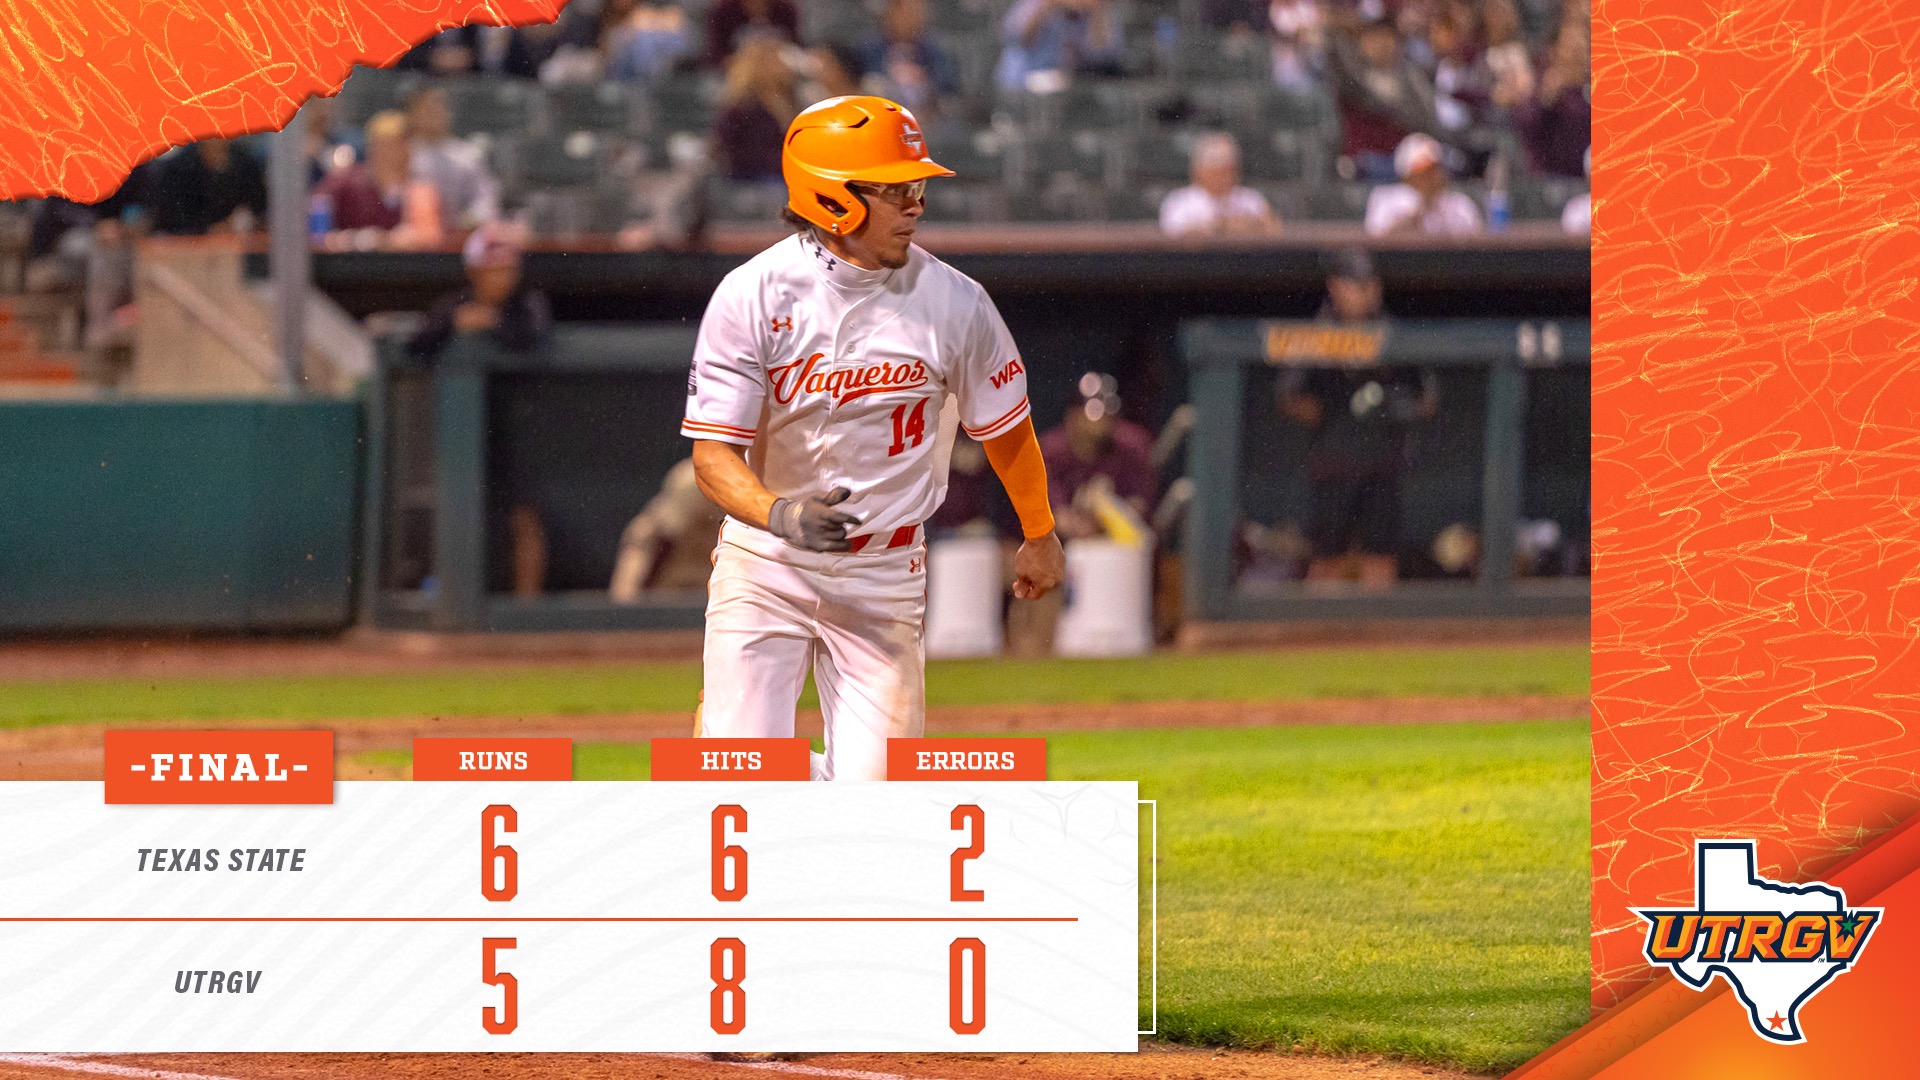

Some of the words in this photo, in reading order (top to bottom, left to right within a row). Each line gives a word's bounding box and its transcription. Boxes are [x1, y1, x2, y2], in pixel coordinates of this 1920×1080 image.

[767, 352, 929, 410] Vaqueros
[989, 357, 1025, 390] WA
[887, 396, 931, 458] 14
